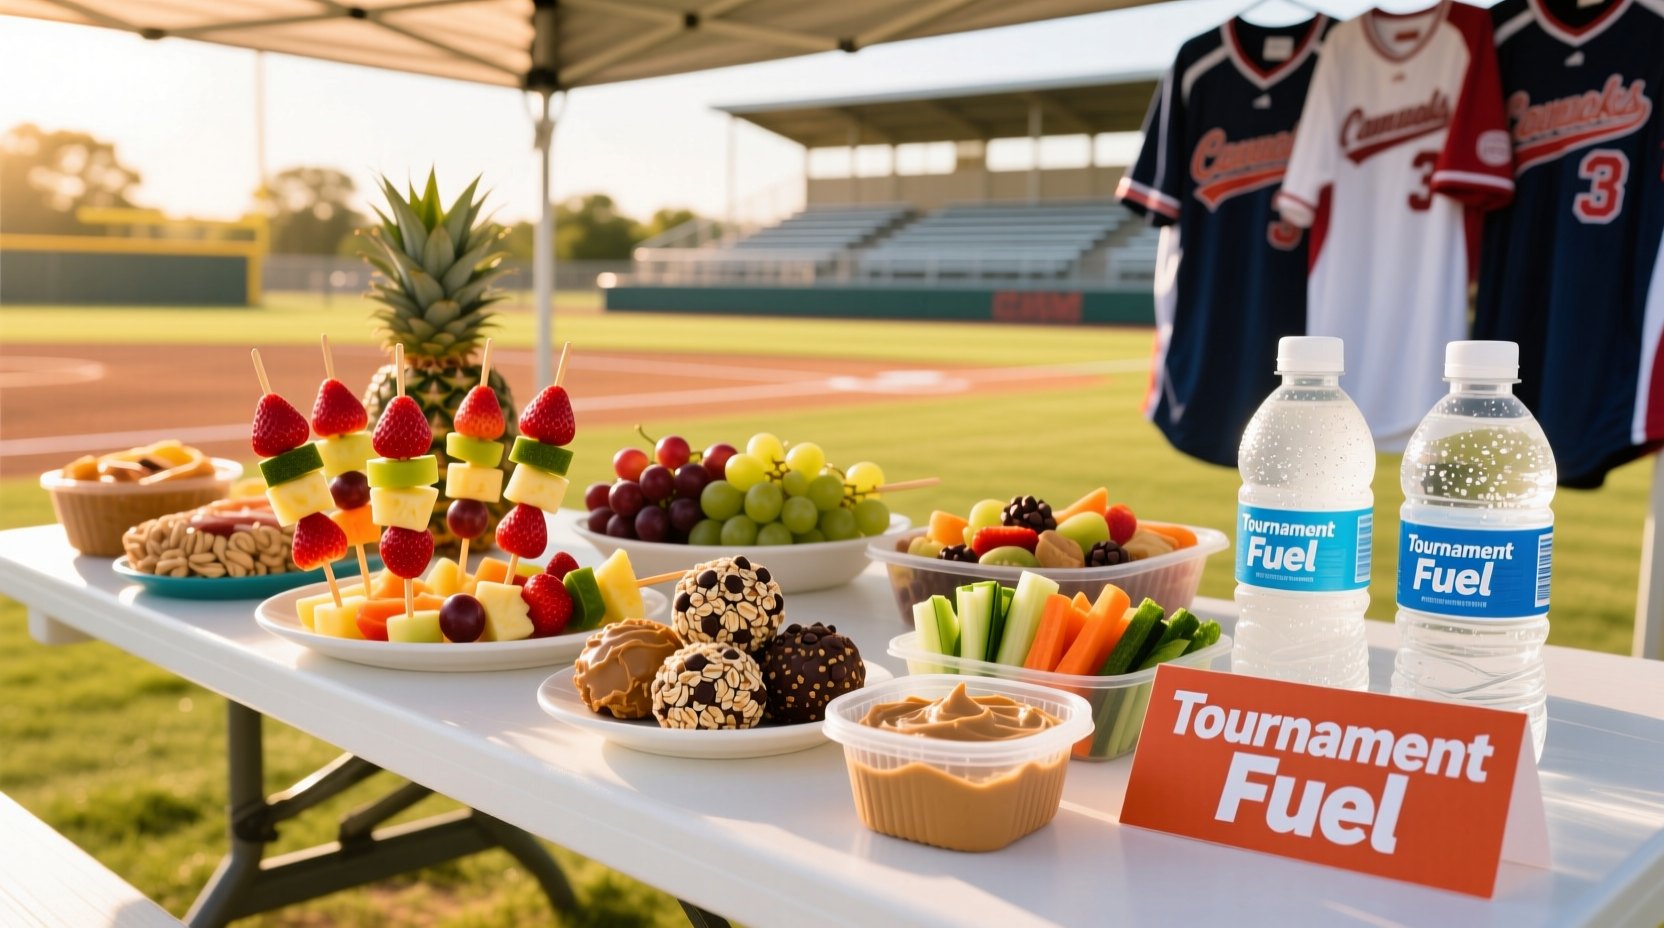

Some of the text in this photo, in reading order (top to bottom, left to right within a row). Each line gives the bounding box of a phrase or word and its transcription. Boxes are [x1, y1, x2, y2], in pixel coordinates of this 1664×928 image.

[1408, 151, 1440, 211] 3
[1572, 148, 1630, 225] 3
[1242, 513, 1336, 538] Tournament
[1408, 533, 1515, 560] Tournament
[1247, 535, 1318, 572] Fuel
[1413, 558, 1494, 597] Fuel
[1173, 689, 1495, 783] Tournament
[1214, 751, 1409, 855] Fuel
